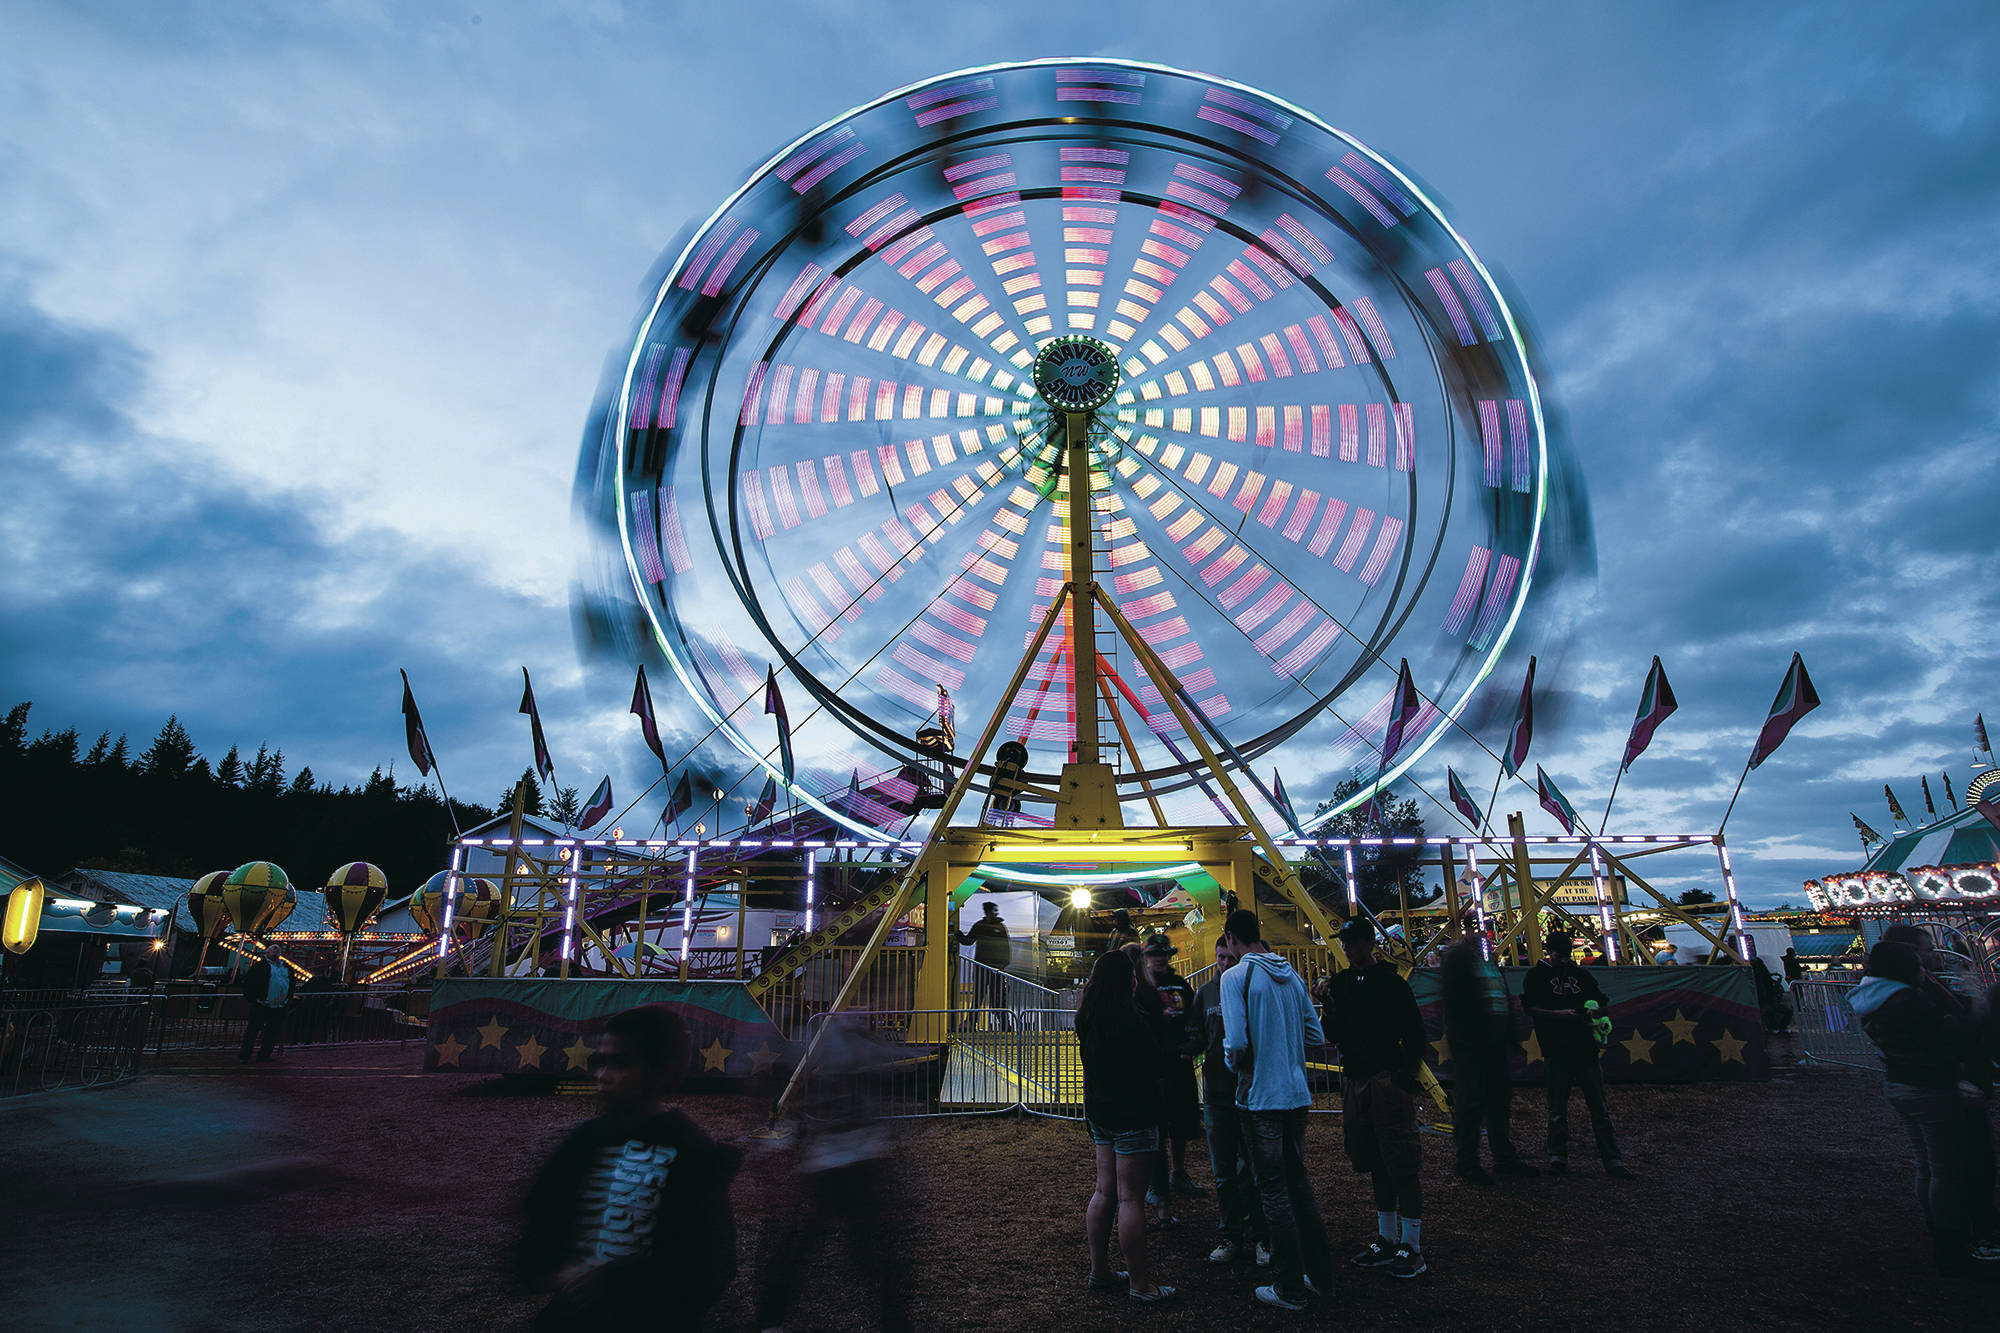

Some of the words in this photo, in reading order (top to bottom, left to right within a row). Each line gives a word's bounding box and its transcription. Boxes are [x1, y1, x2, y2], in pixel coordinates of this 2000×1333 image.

[1045, 343, 1108, 367] DAVIS
[1061, 365, 1089, 377] NW
[1044, 378, 1108, 402] SHOWS
